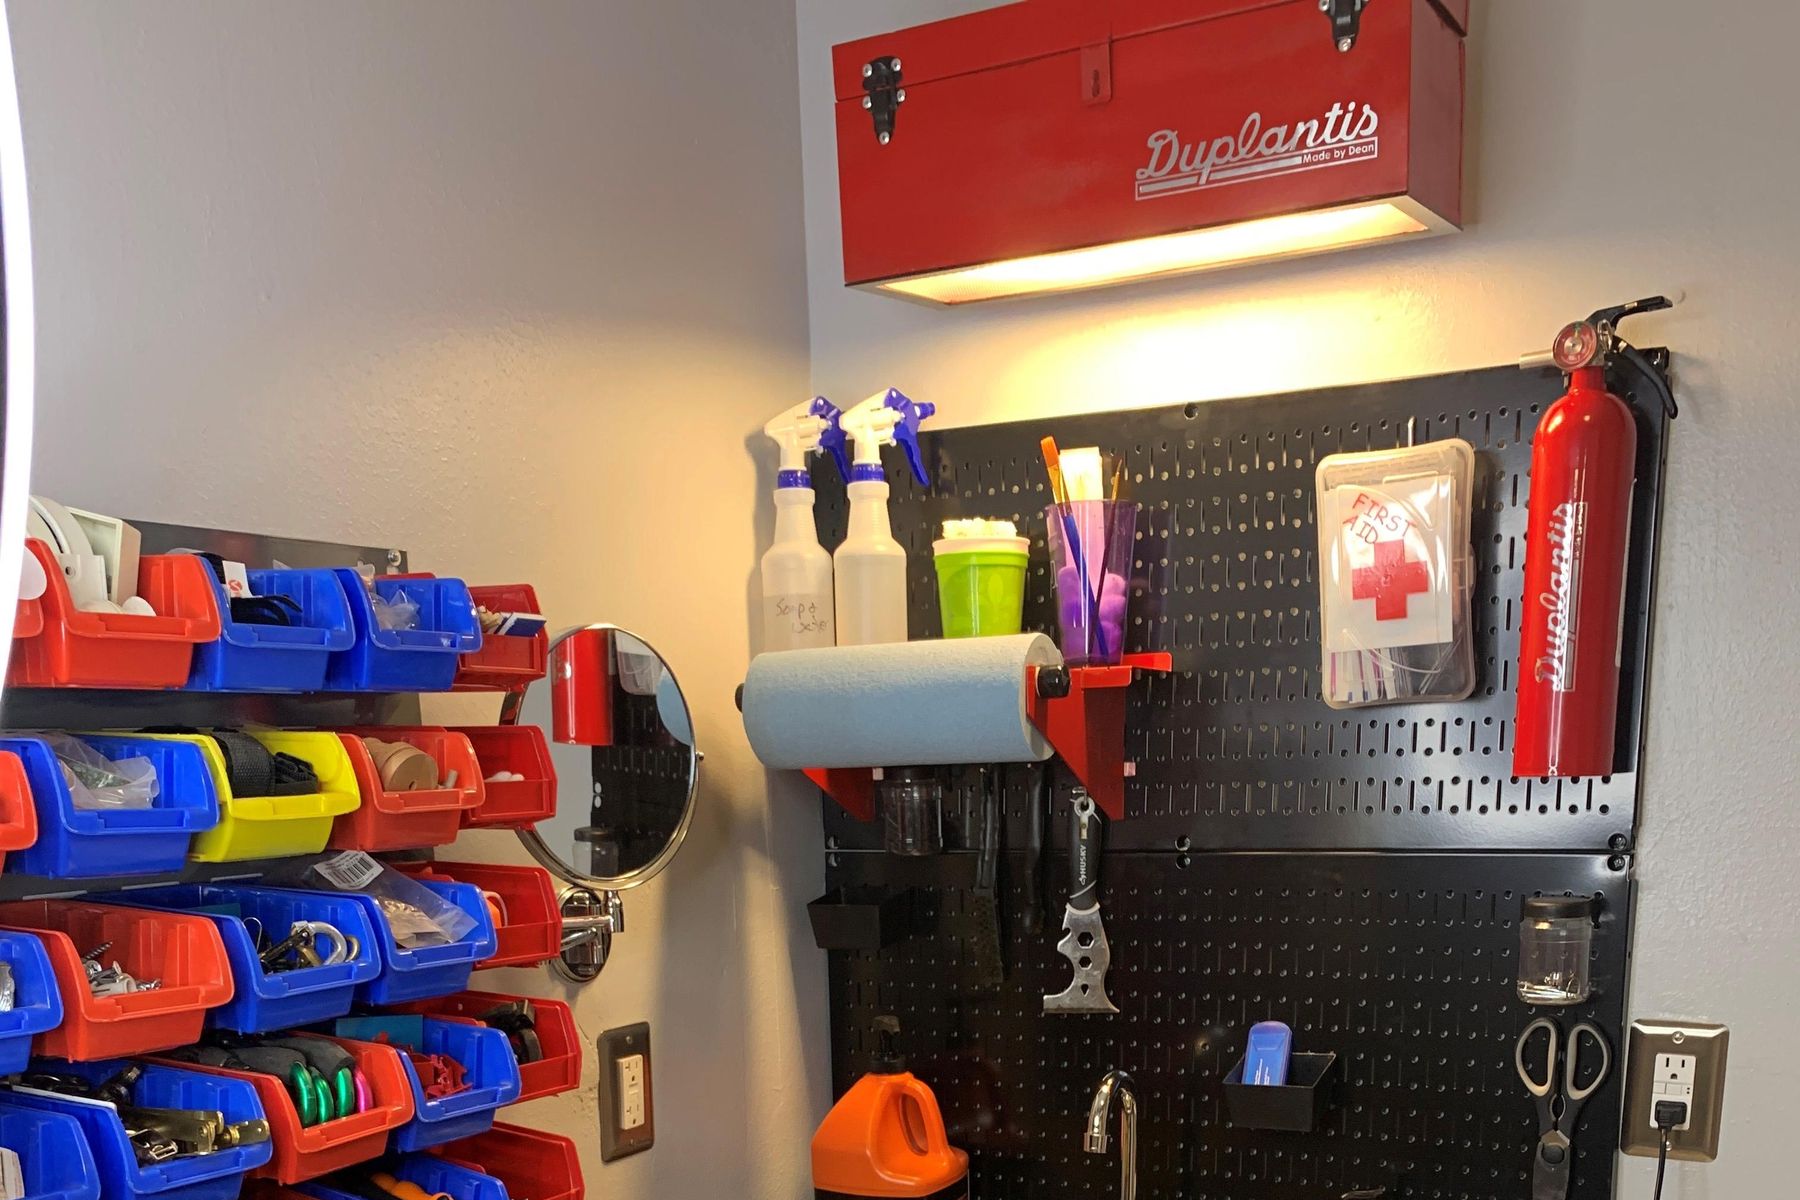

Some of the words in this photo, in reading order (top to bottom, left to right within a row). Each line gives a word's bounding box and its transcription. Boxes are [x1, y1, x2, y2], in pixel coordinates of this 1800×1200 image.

[1136, 101, 1378, 185] Duplantis
[1303, 152, 1331, 164] Made
[1333, 149, 1346, 160] by
[1349, 143, 1374, 156] Dean
[1342, 514, 1379, 545] AID
[1352, 492, 1417, 537] FIRST
[1534, 502, 1576, 692] Duplantis
[1079, 844, 1087, 876] HUSKY
